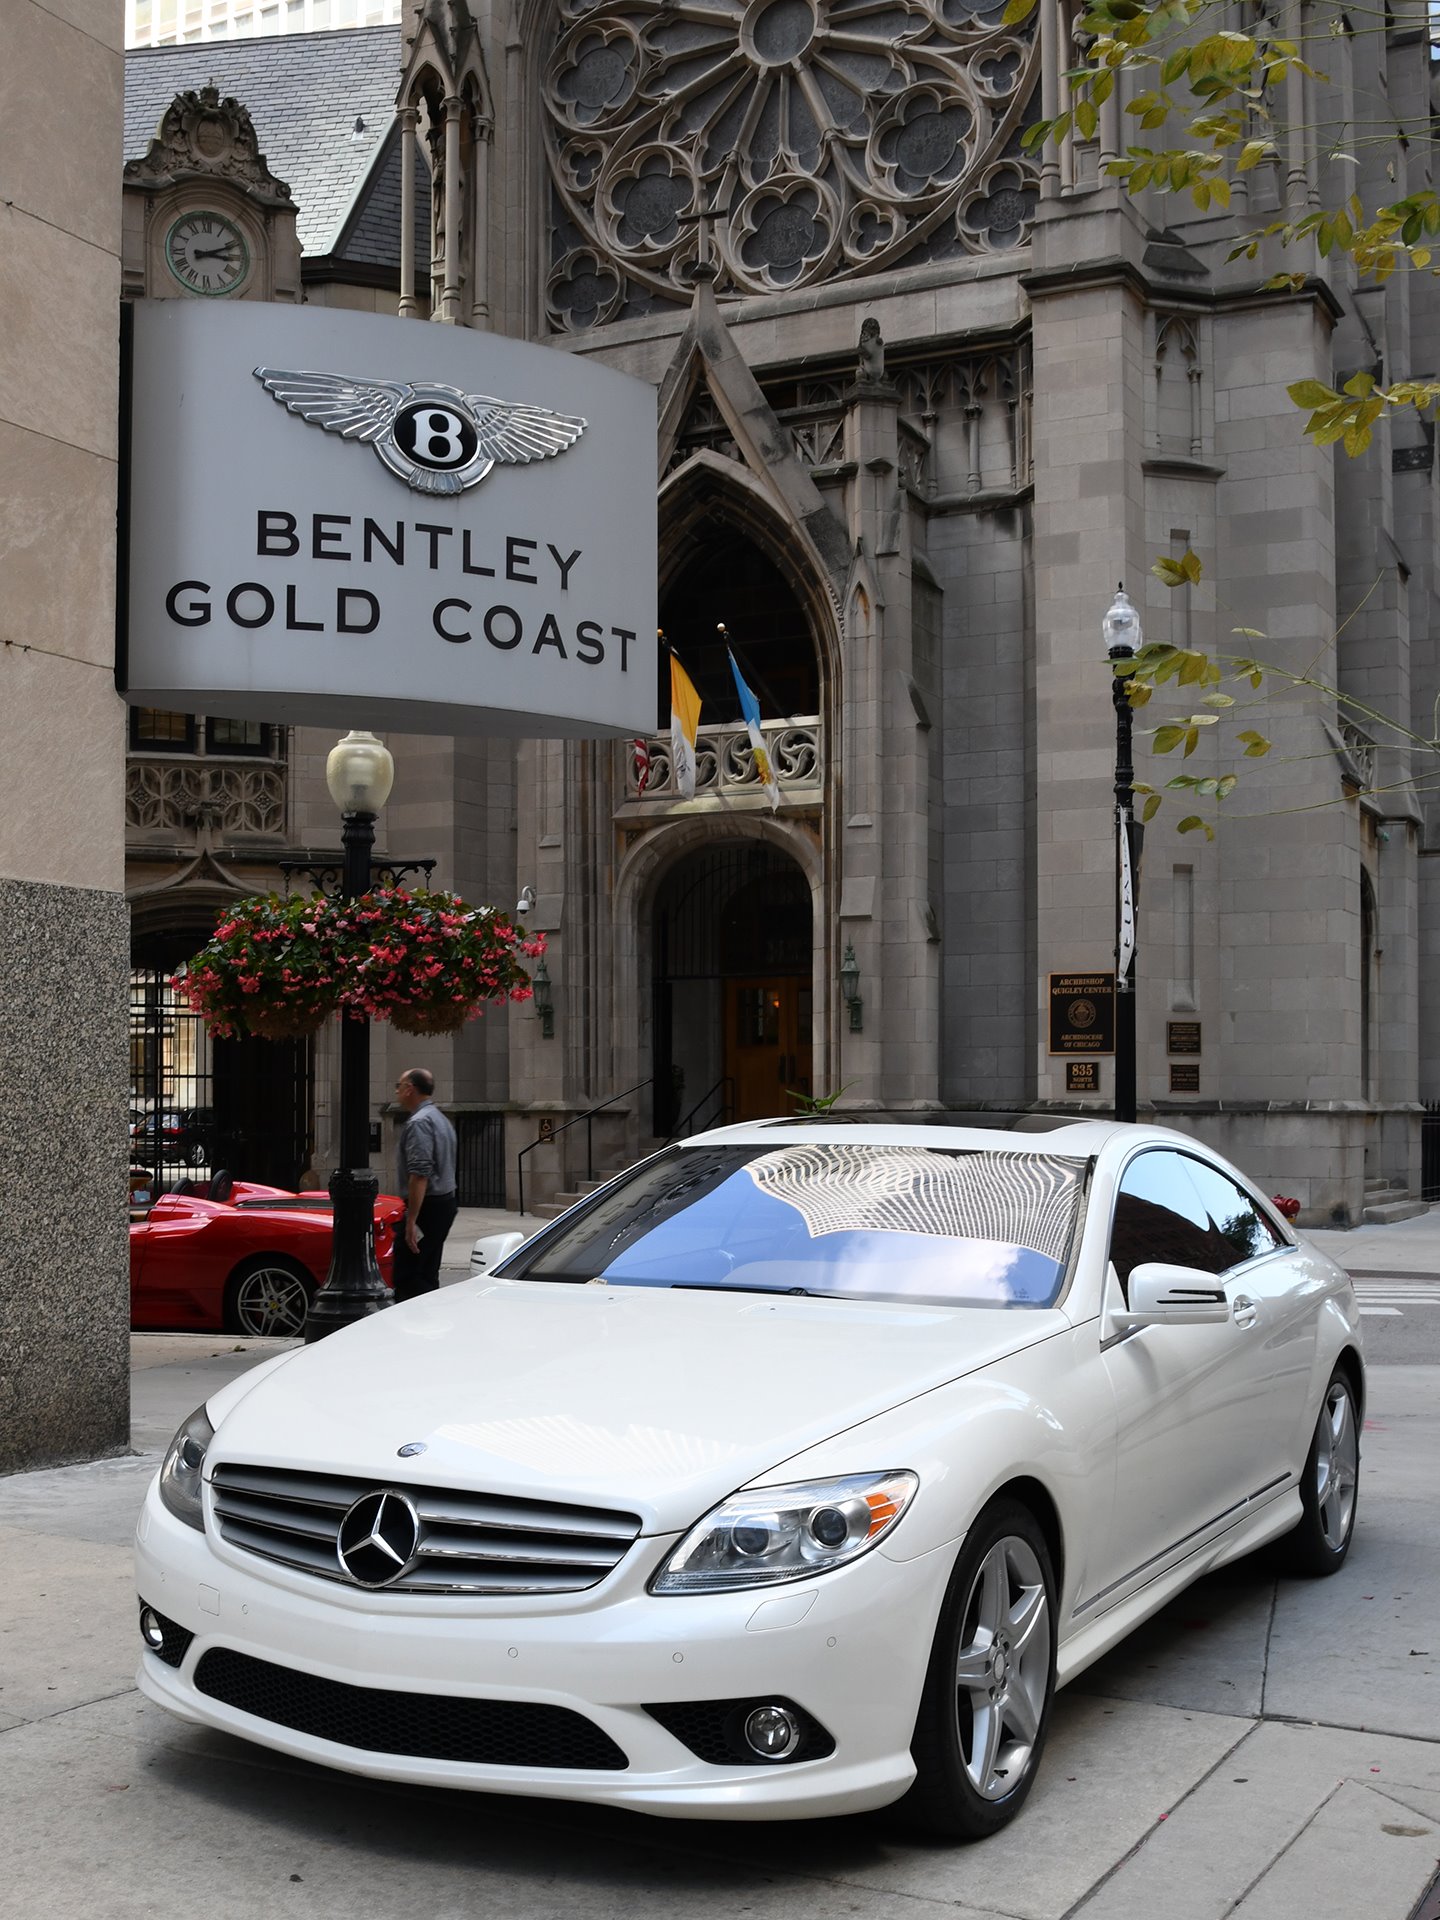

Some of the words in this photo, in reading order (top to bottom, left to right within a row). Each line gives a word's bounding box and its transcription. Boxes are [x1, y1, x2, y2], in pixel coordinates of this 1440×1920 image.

[411, 408, 465, 463] B
[256, 509, 582, 591] BENTLEY
[165, 580, 381, 635] GOLD
[432, 598, 637, 673] COAST
[1059, 977, 1105, 986] ARCHBISHOP
[1052, 987, 1083, 995] QUIGLEY
[1084, 986, 1112, 994] CENTER
[1061, 1033, 1104, 1041] ARCHDIOCESE
[1071, 1064, 1094, 1076] 835
